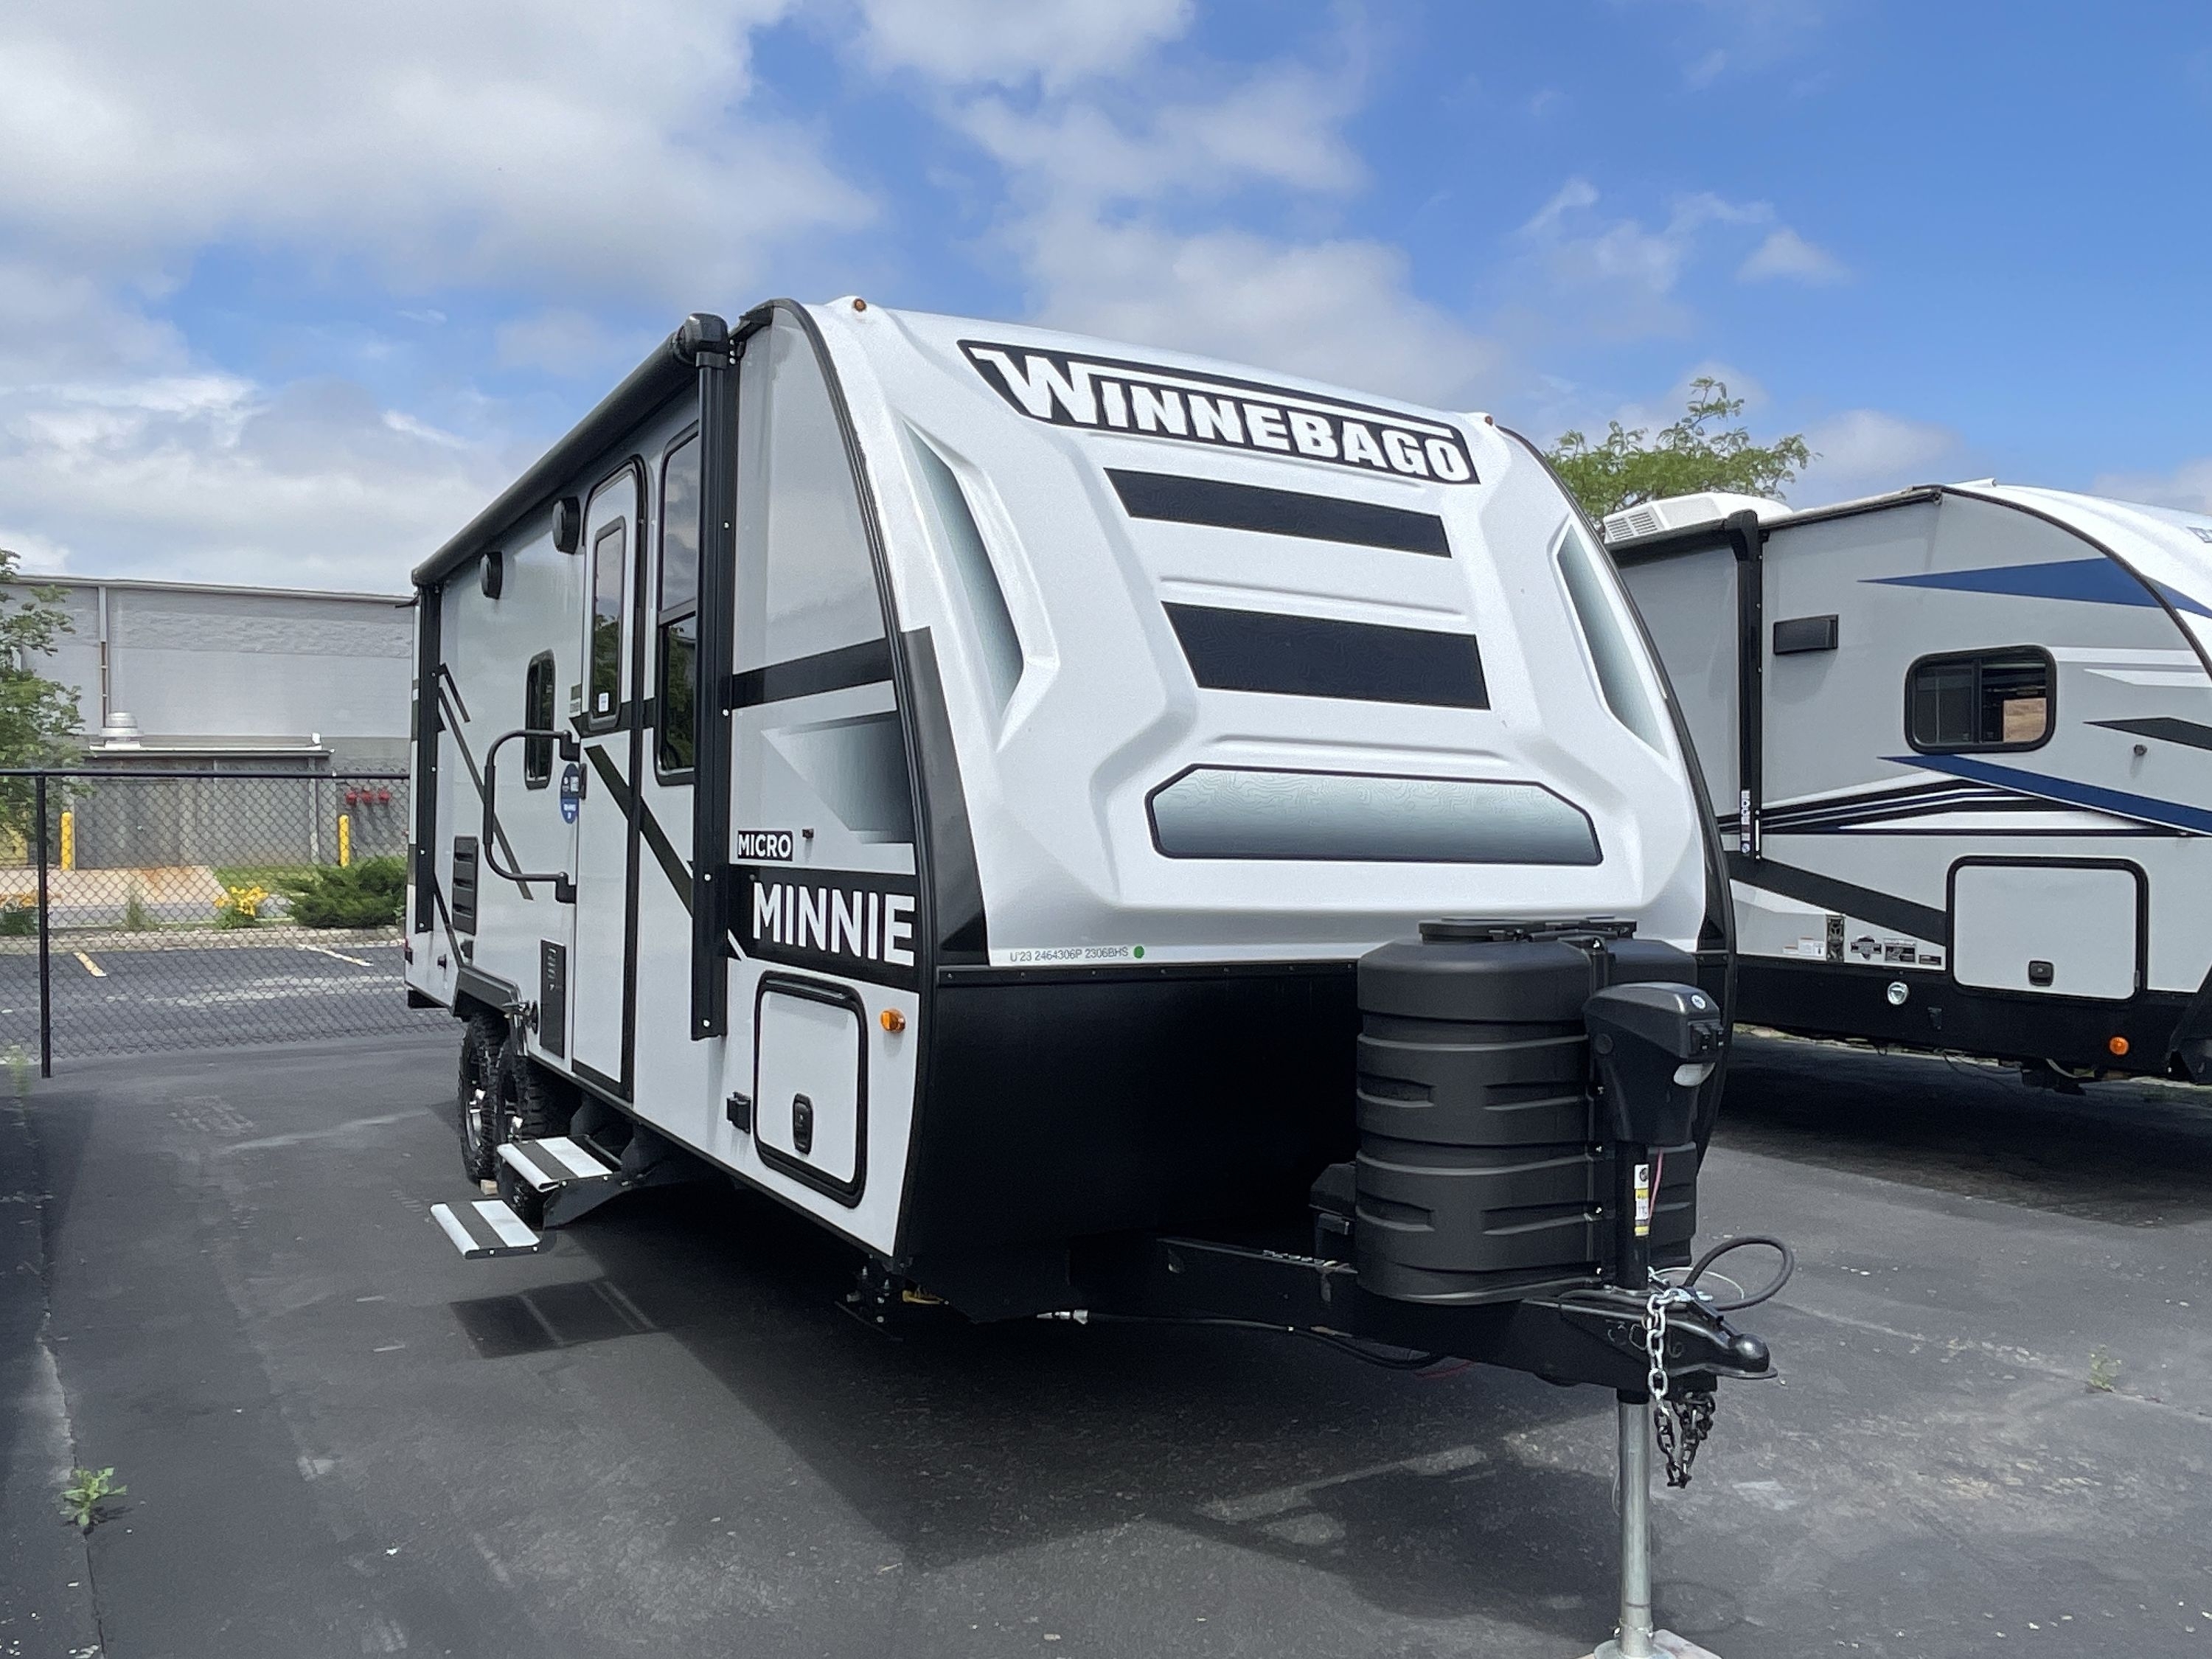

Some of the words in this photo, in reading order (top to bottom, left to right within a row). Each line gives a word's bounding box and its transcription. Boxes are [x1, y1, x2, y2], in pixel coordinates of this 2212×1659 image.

[968, 347, 1471, 481] WINNEBAGO
[738, 833, 792, 858] MICRO
[752, 881, 916, 967] MINNIE
[1084, 945, 1129, 959] 2306BHS
